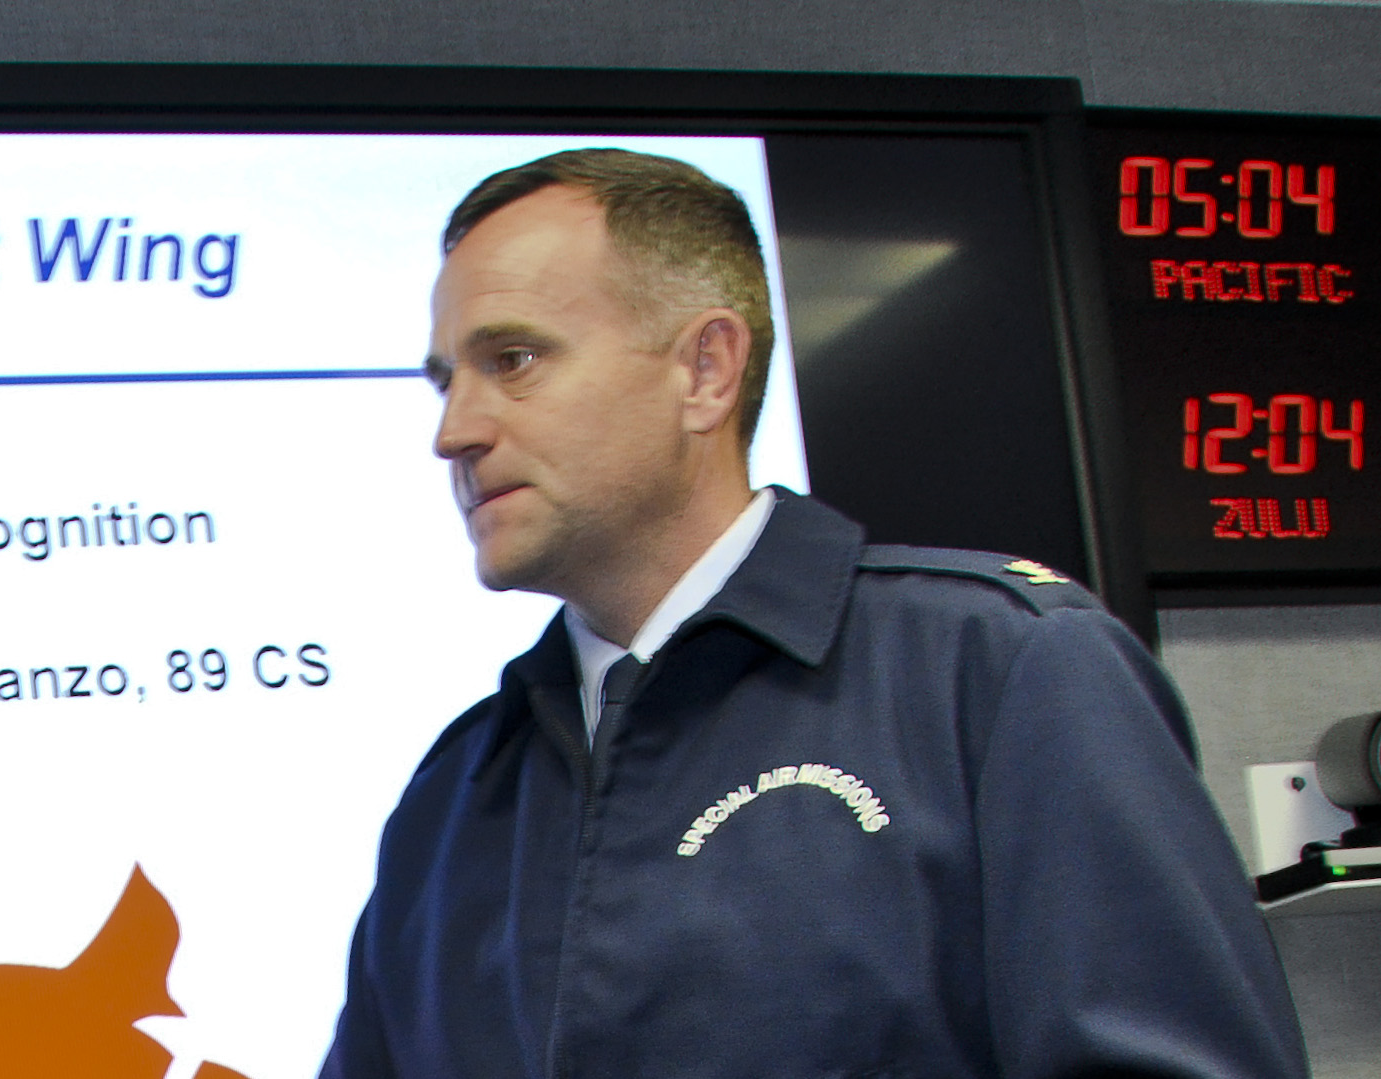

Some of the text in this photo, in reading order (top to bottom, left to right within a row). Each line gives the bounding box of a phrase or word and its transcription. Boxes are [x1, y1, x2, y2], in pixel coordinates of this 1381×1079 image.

[1119, 156, 1335, 238] 05:04
[27, 216, 240, 299] Wing
[1151, 259, 1354, 303] PACIFIC
[1183, 392, 1364, 474] 12:04
[1210, 497, 1330, 539] ZULU
[167, 647, 229, 693] 89
[252, 642, 331, 690] CS
[676, 763, 891, 857] SPECIAL AIR MISSIONS
